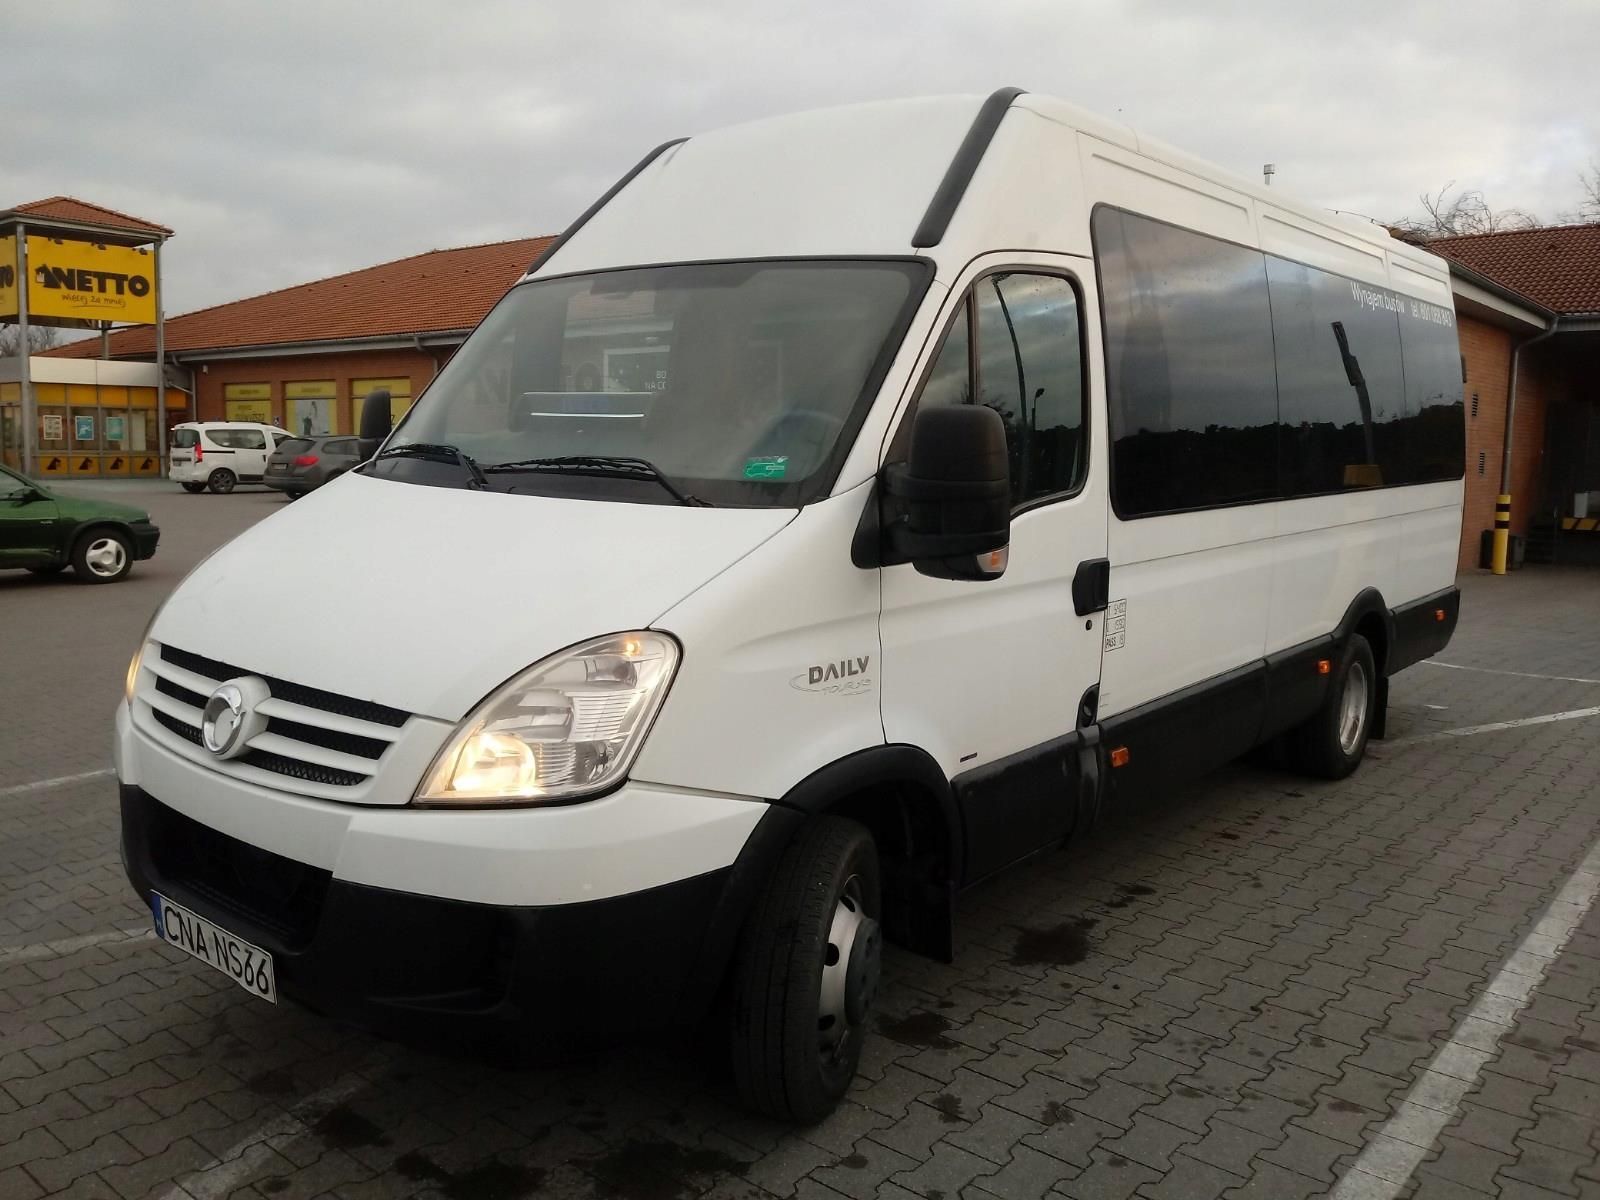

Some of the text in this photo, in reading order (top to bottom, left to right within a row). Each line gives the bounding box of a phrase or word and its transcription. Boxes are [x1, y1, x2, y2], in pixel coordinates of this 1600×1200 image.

[49, 266, 150, 297] NETTO
[808, 655, 870, 685] DAILY
[164, 905, 210, 960] CNA
